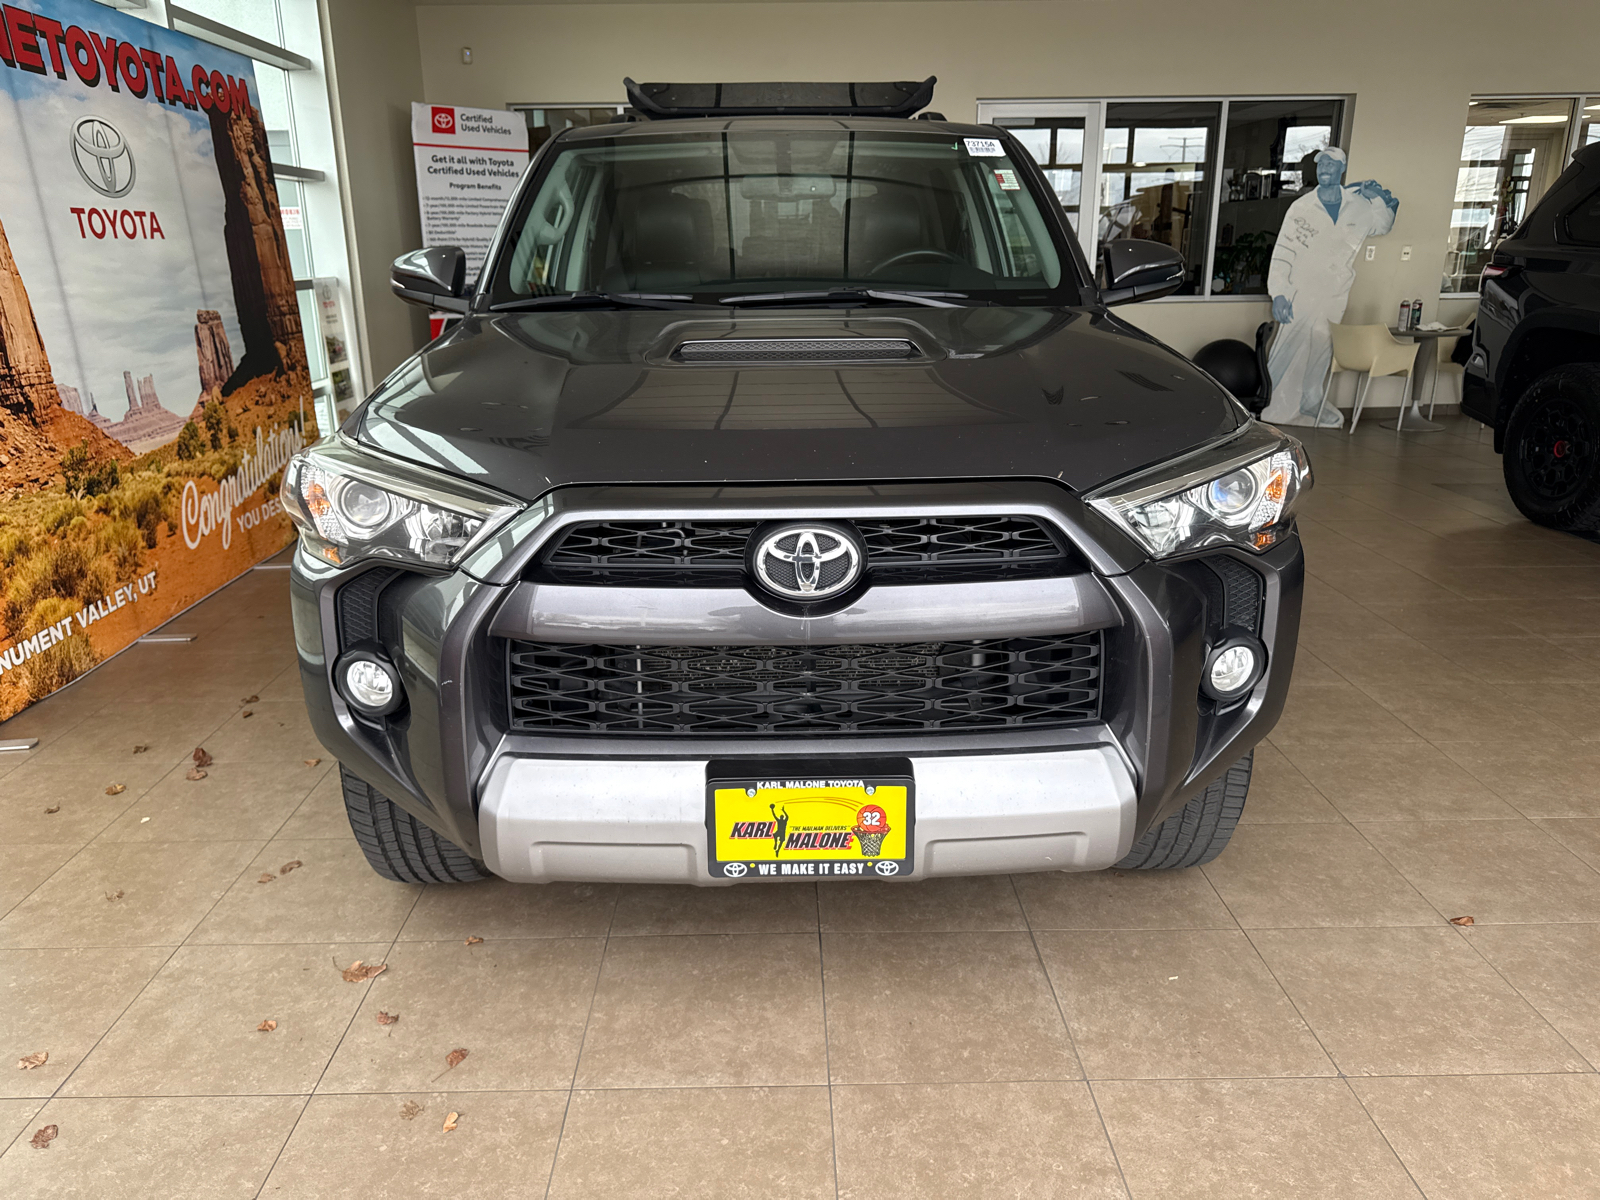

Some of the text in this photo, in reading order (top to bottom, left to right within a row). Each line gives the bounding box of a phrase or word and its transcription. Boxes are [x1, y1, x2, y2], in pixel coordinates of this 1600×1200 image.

[460, 113, 493, 124] Certified
[461, 124, 512, 135] Used Vehicles
[431, 155, 514, 167] Get it all with Toyota
[427, 166, 519, 178] Certified Used Vehicles
[449, 182, 476, 190] Program
[70, 207, 165, 240] TOYOTA
[182, 394, 306, 550] Congratulations!
[236, 508, 261, 533] YOU
[75, 583, 138, 629] VALLEY,
[137, 571, 156, 594] UT
[757, 781, 783, 789] KARL
[828, 780, 865, 788] TOYOTA
[862, 811, 881, 826] 32
[730, 821, 776, 839] KARL
[784, 832, 854, 850] MALONE
[758, 862, 864, 875] WE MAKE IT EASY
